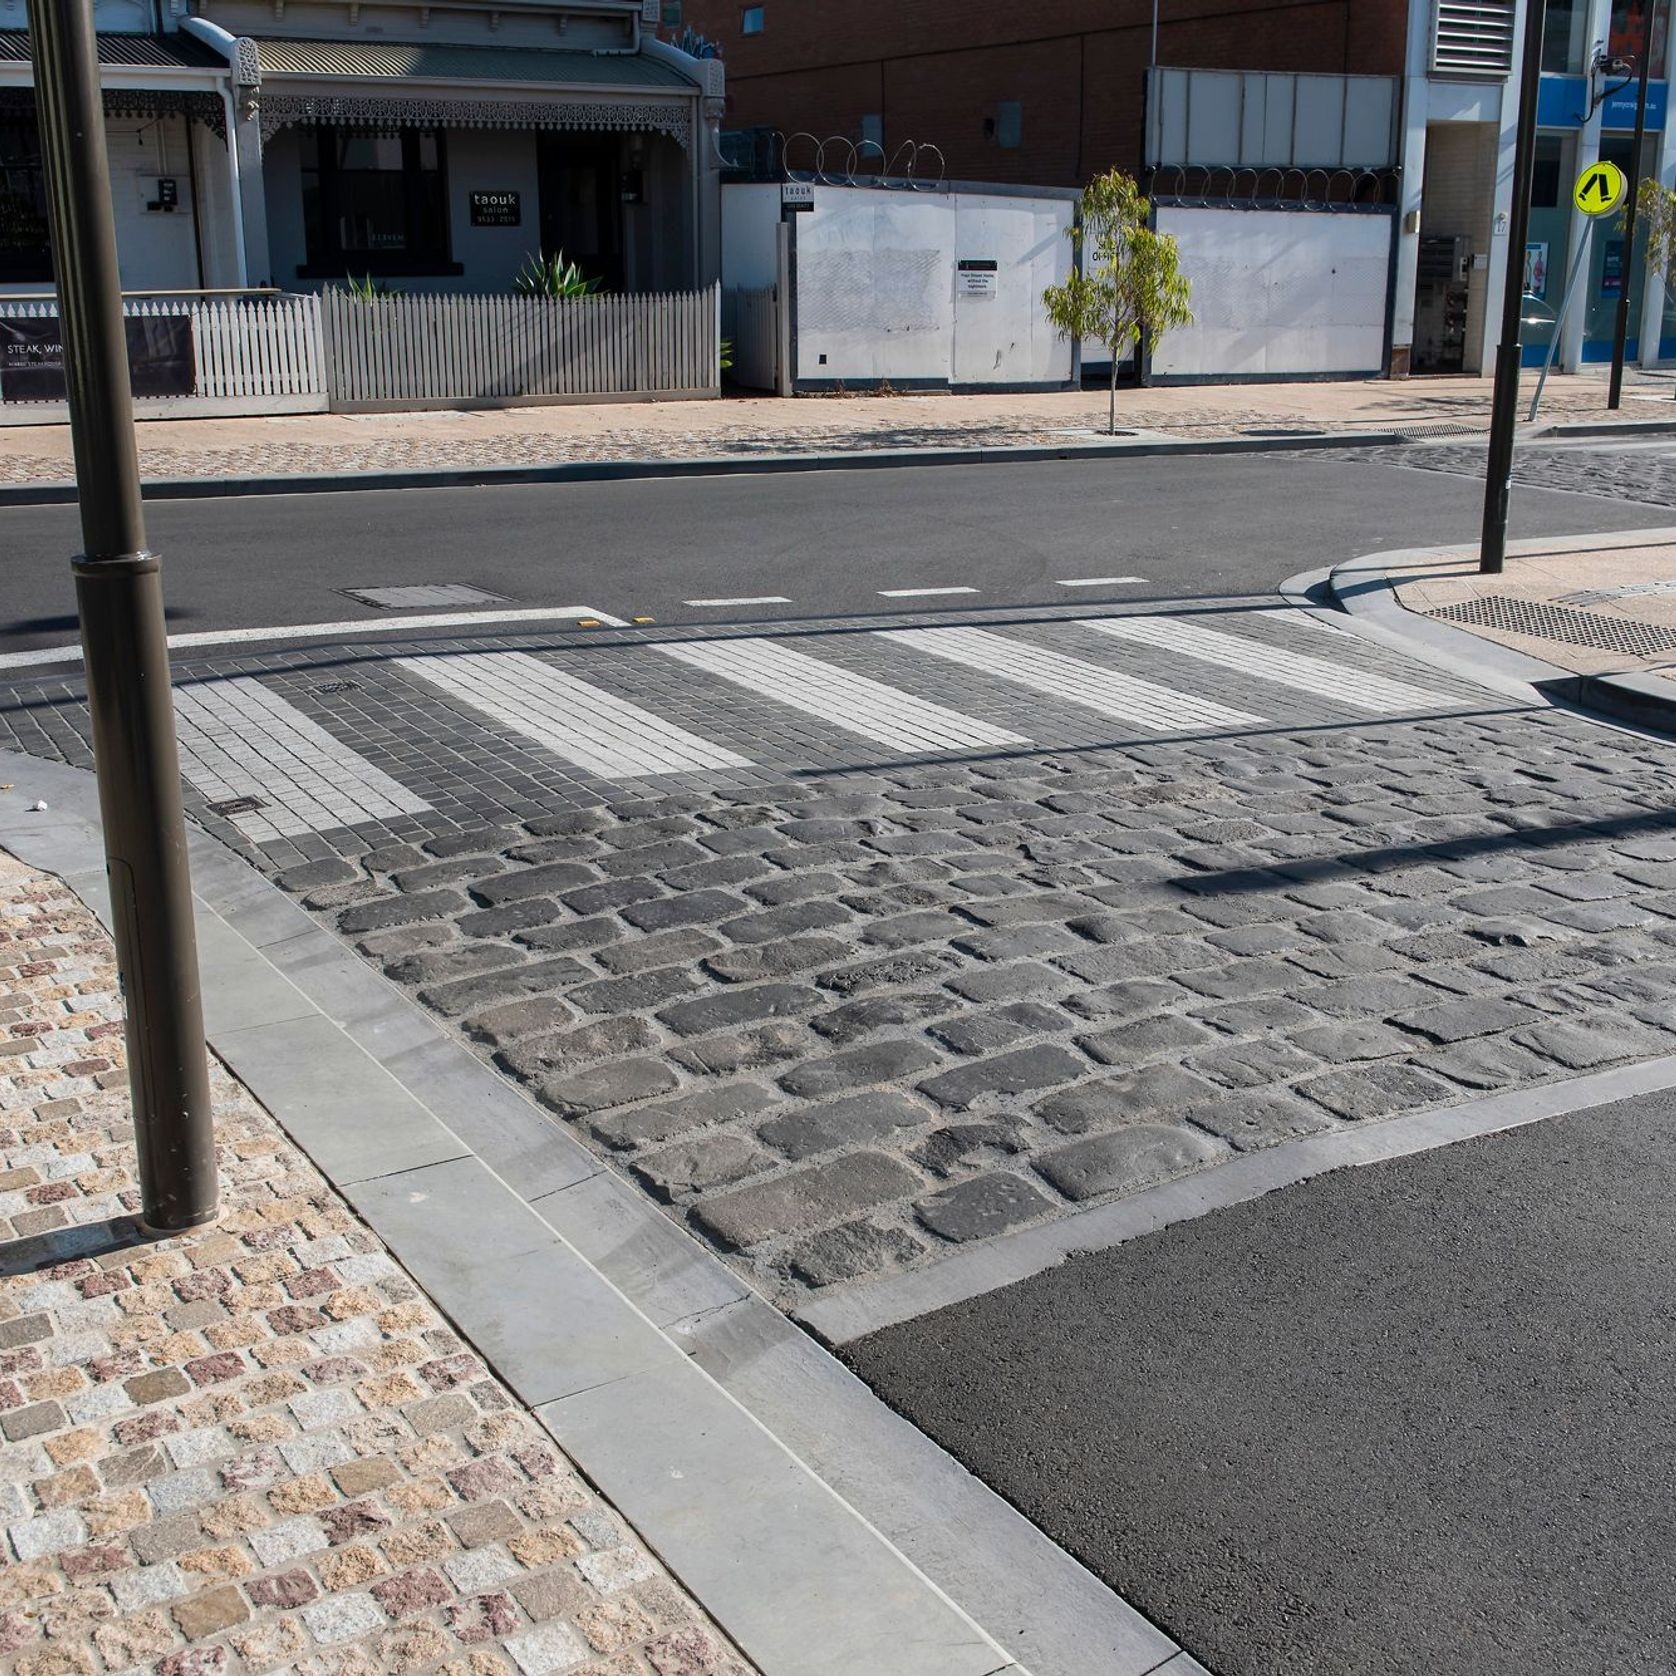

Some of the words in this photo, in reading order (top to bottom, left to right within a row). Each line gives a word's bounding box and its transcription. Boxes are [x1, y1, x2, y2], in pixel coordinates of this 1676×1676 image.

[474, 194, 516, 205] taouk
[7, 344, 42, 355] STEAK,
[44, 344, 64, 354] WIN
